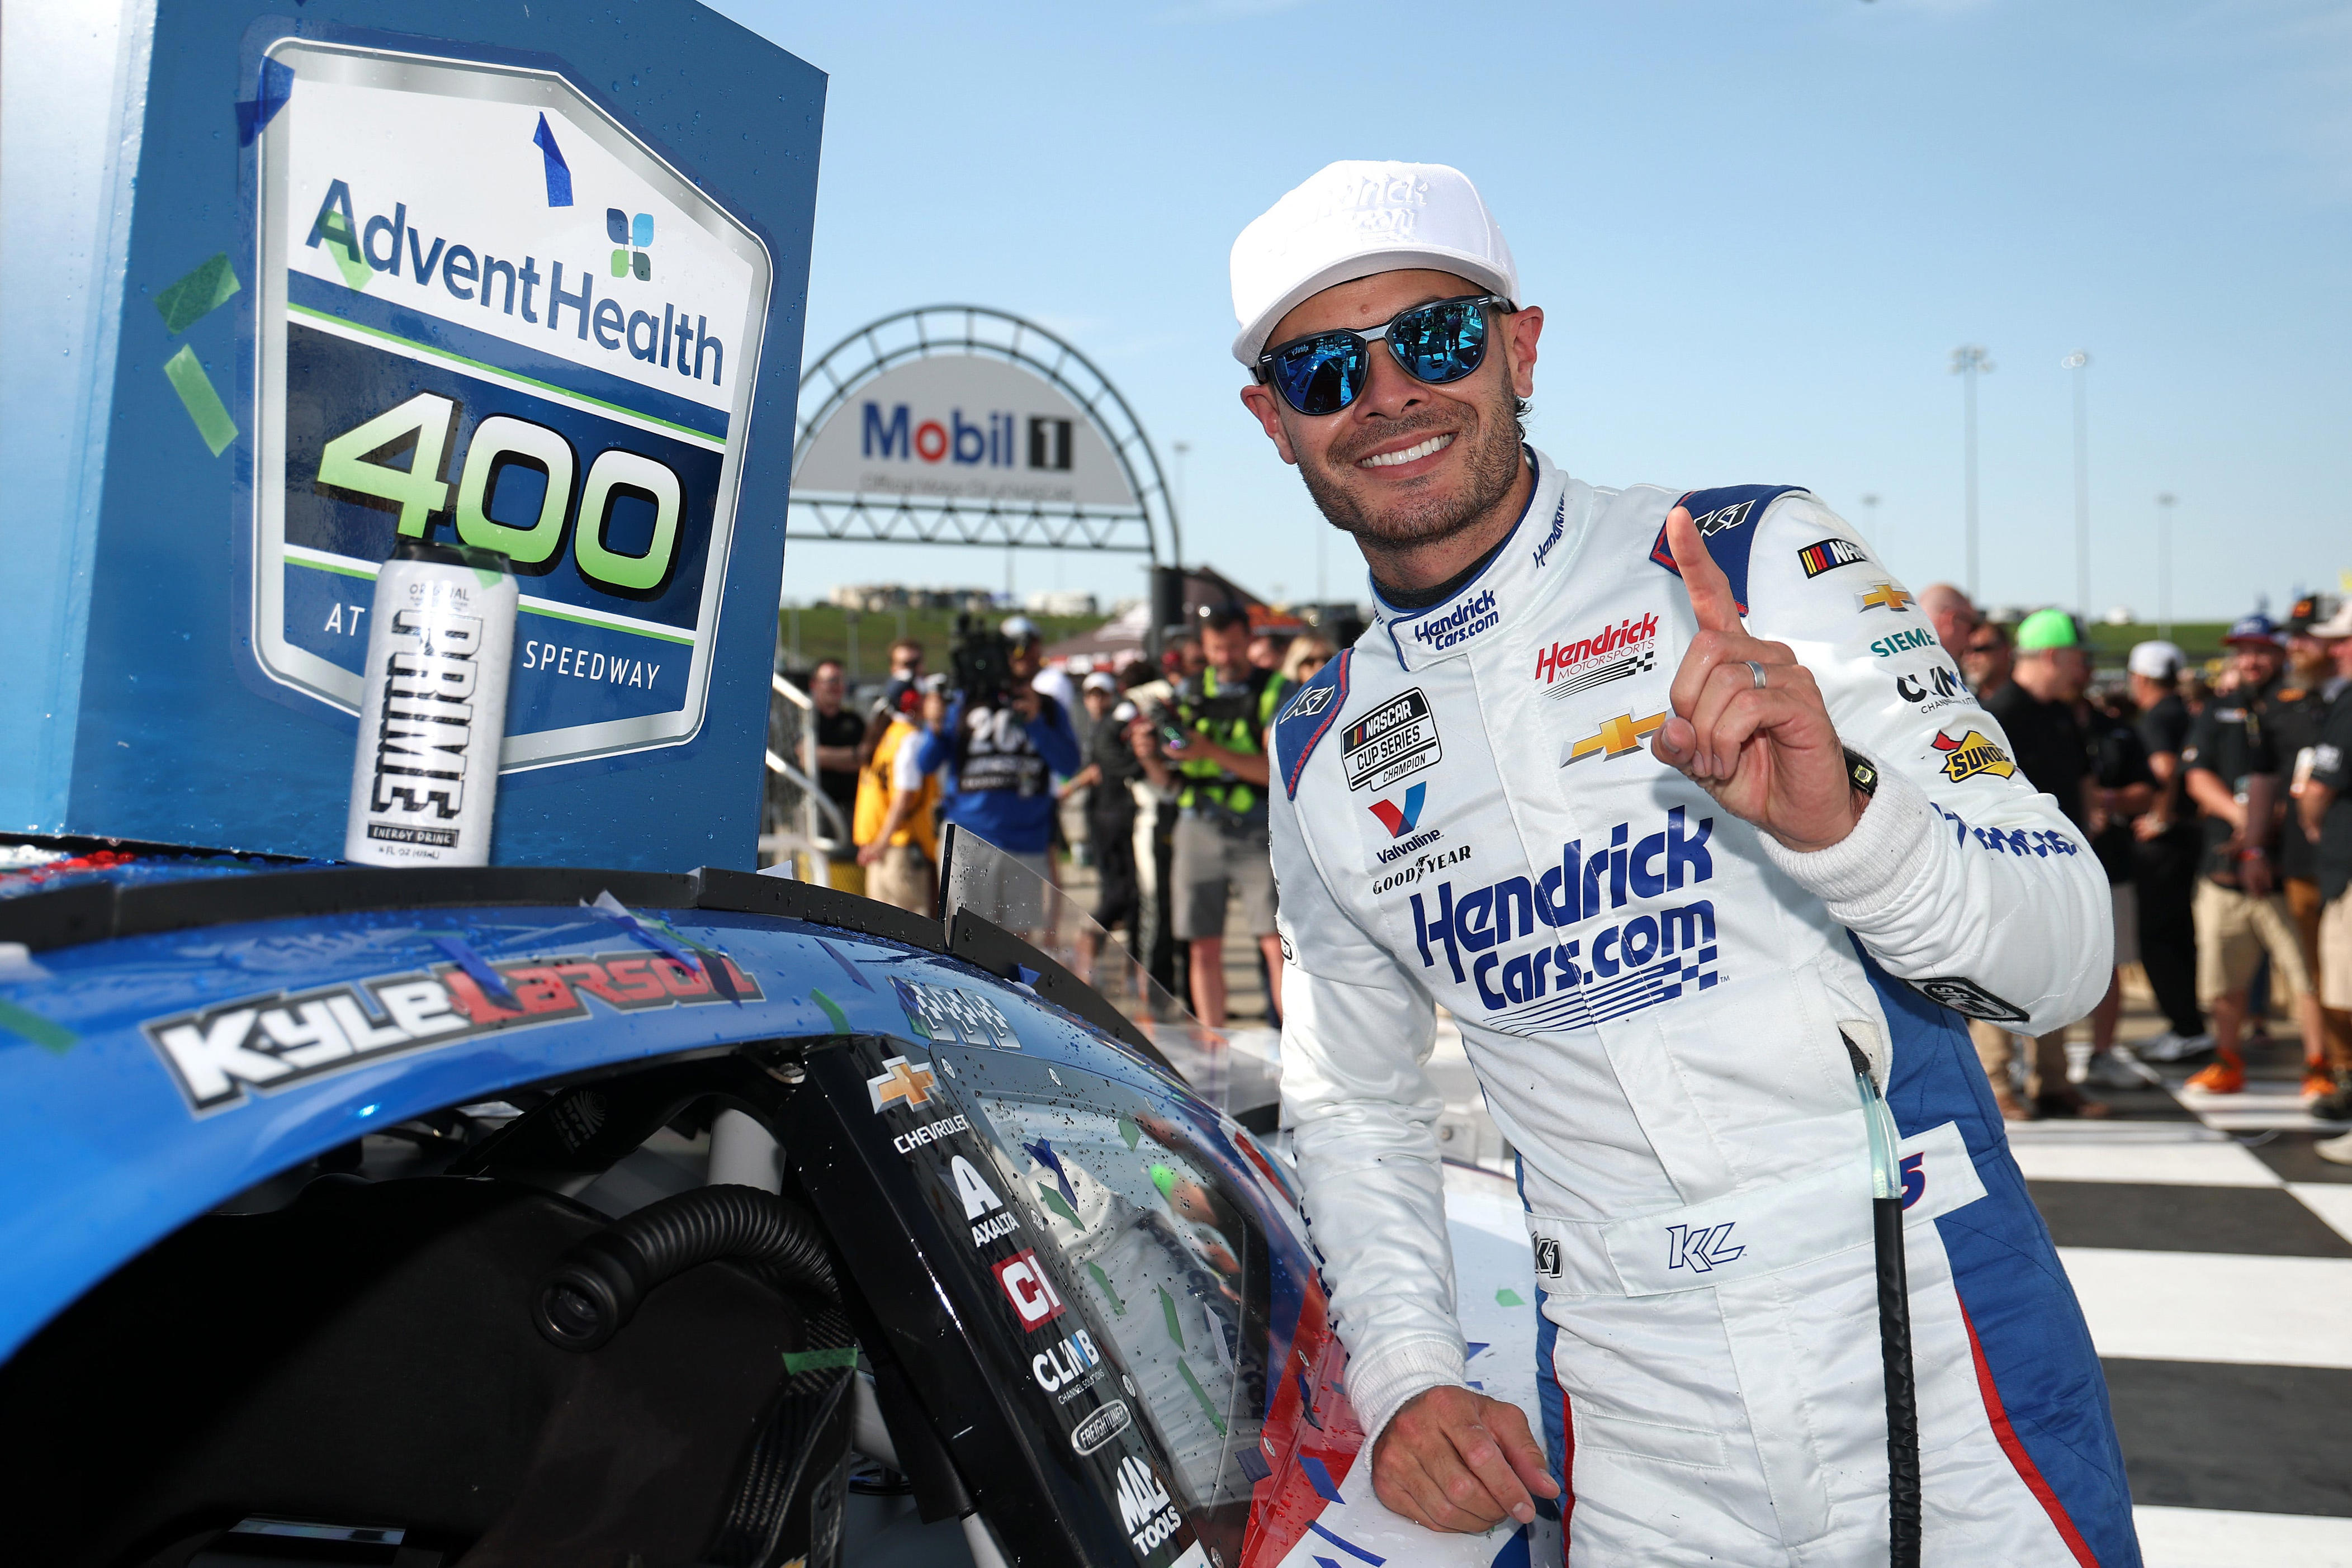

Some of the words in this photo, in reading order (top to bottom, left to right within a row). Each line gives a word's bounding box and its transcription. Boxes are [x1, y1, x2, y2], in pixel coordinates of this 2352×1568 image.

[305, 178, 723, 386] AdventHealth
[861, 400, 1015, 468] Mobil
[1033, 417, 1067, 471] 1
[316, 390, 684, 595] 400
[1415, 589, 1496, 645] Hendrick
[1435, 611, 1499, 651] Cars.com
[324, 603, 365, 636] AT
[523, 640, 661, 690] SPEEDWAY
[1535, 612, 1659, 684] Hendrick
[1557, 638, 1655, 681] MOTORSPORTS
[370, 609, 483, 820] PRIME
[1366, 700, 1412, 739] NASCAR
[1357, 746, 1379, 770] CUP
[1380, 724, 1420, 758] SERIES
[1383, 752, 1426, 783] CHAMPION
[1952, 746, 2010, 776] SUNOC
[372, 826, 414, 841] ENERGY
[417, 830, 452, 844] DRINK
[1376, 830, 1441, 864] Valvoline
[1373, 845, 1471, 895] GOODYEAR
[1409, 805, 1714, 984] Hendrick
[1473, 899, 1716, 1010] Cars.com
[893, 1114, 969, 1154] CHEVROLET
[971, 1211, 1020, 1248] AXALTA
[1033, 1329, 1100, 1392] CLIMB
[1058, 1384, 1085, 1404] CHANNEL
[1082, 1368, 1105, 1389] SOLUTIONS
[1080, 1405, 1127, 1448] FREIGHTLINER
[1117, 1456, 1170, 1534] MAC
[1132, 1505, 1182, 1556] TOOLS
